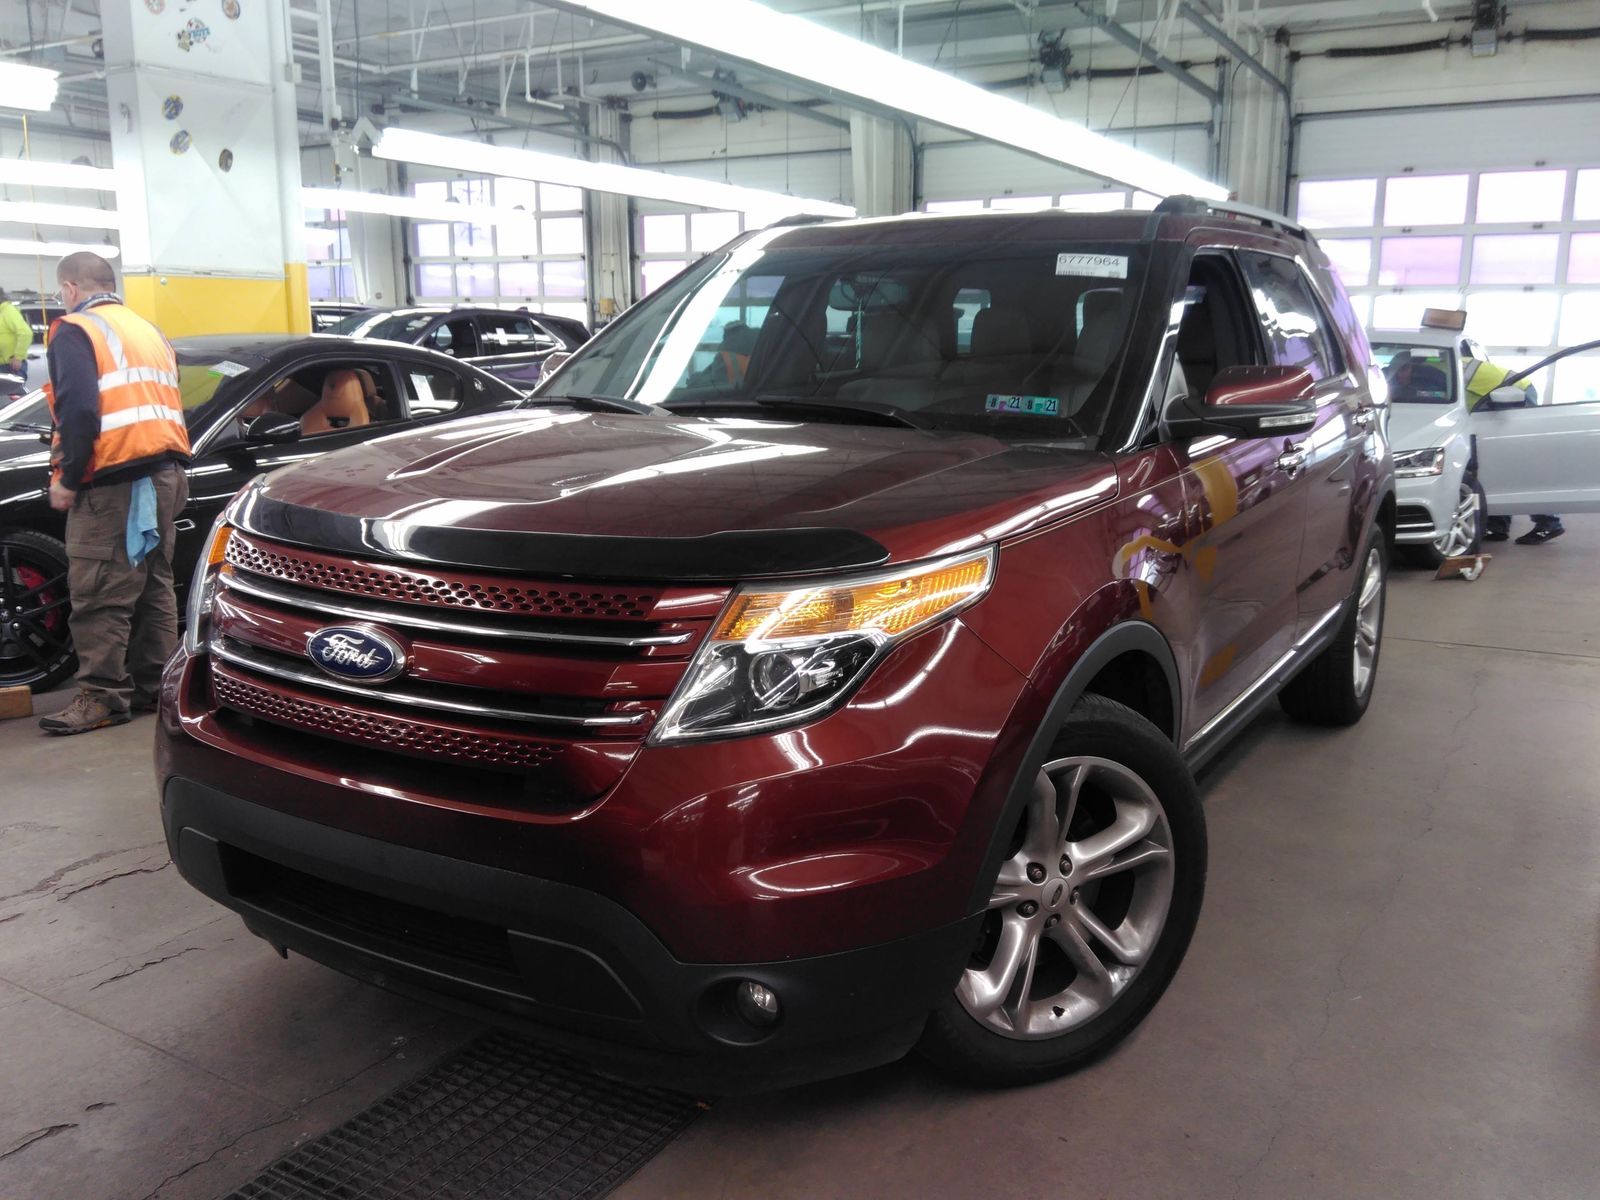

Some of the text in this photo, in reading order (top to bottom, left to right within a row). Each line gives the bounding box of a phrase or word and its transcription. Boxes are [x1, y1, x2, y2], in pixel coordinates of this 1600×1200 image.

[1059, 255, 1120, 267] 6777964
[1009, 396, 1020, 409] 21
[1046, 399, 1057, 412] 21
[321, 633, 384, 669] Ford
